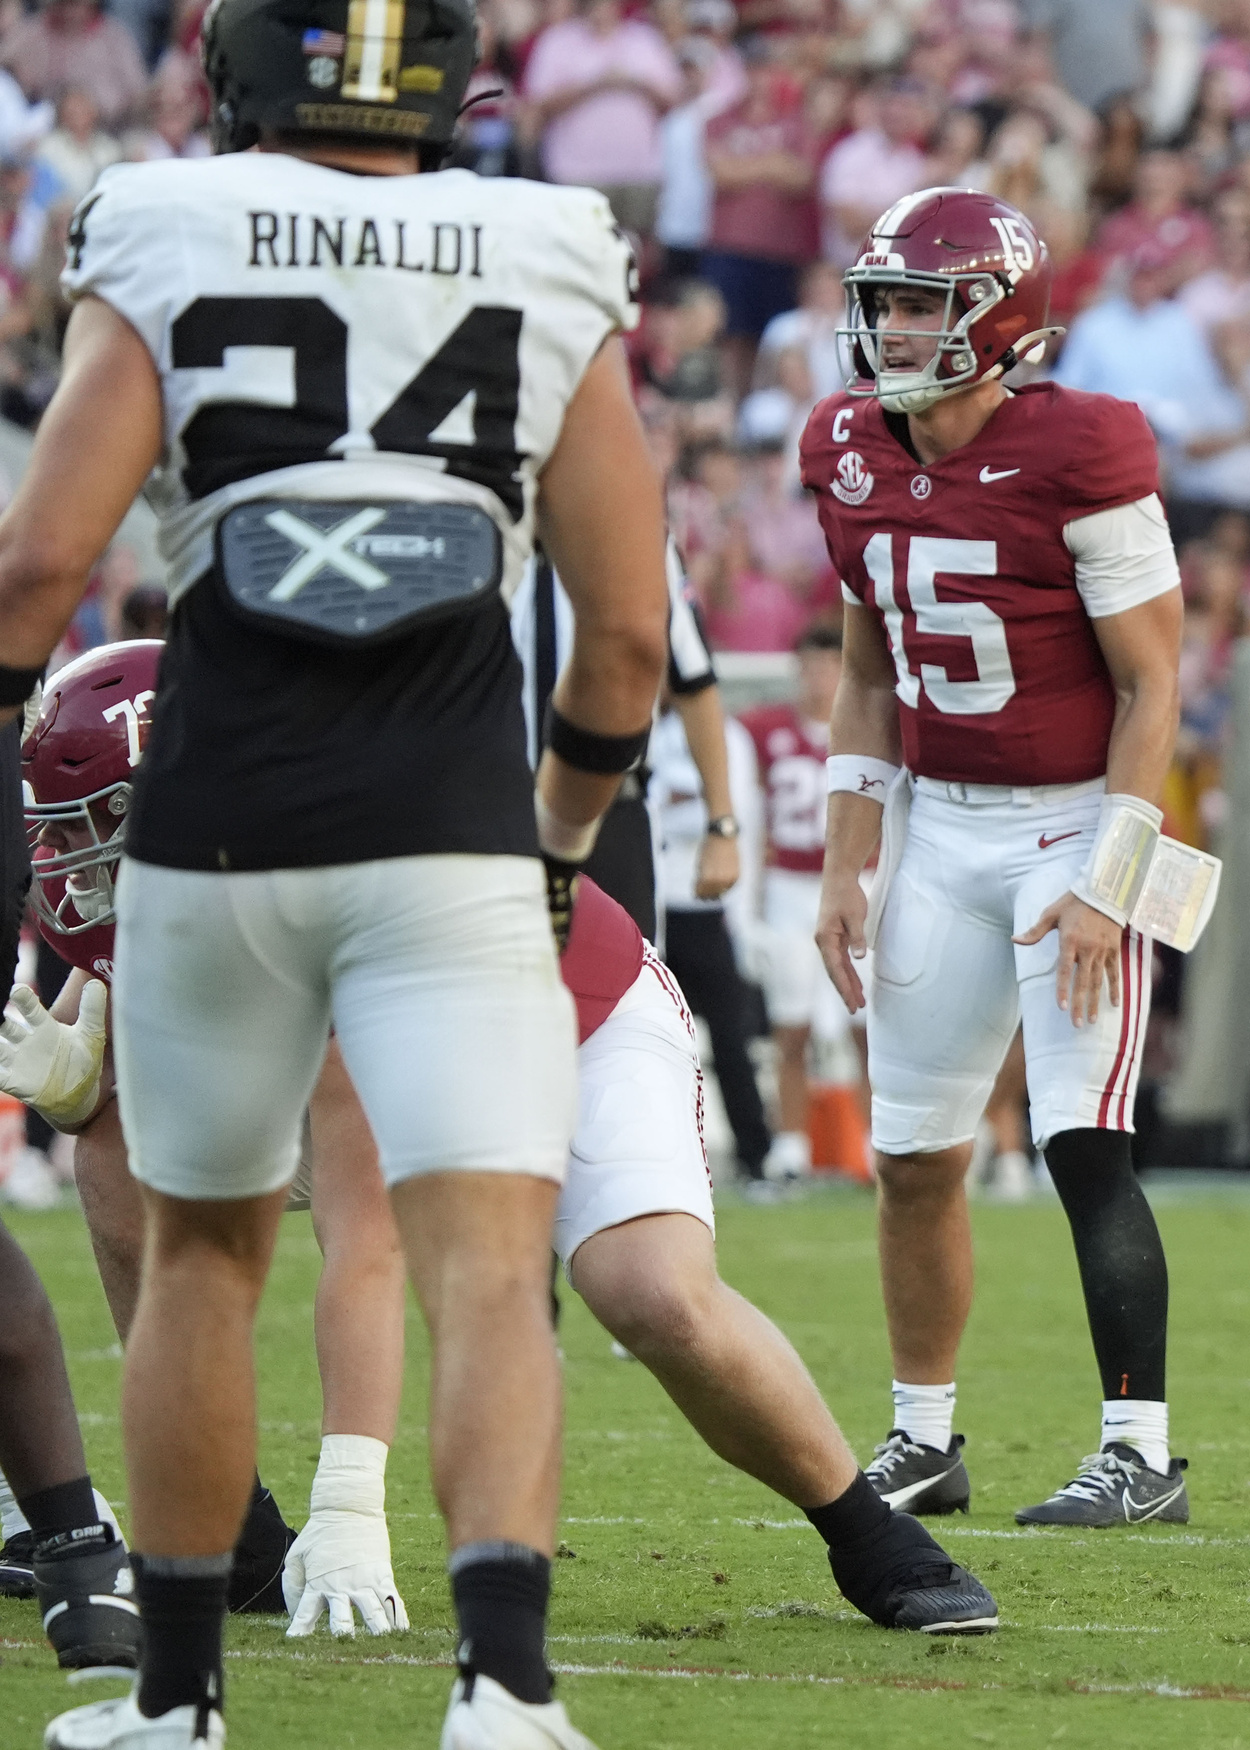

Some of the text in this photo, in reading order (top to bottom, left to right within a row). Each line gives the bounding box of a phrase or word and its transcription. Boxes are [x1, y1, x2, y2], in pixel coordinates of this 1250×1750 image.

[248, 210, 484, 278] RINALDI
[989, 216, 1035, 271] 15
[171, 296, 529, 522] 24
[832, 408, 855, 443] C
[836, 485, 869, 503] GRADUATE
[837, 451, 866, 490] SEC
[862, 532, 1016, 715] 15
[102, 690, 155, 768] 7
